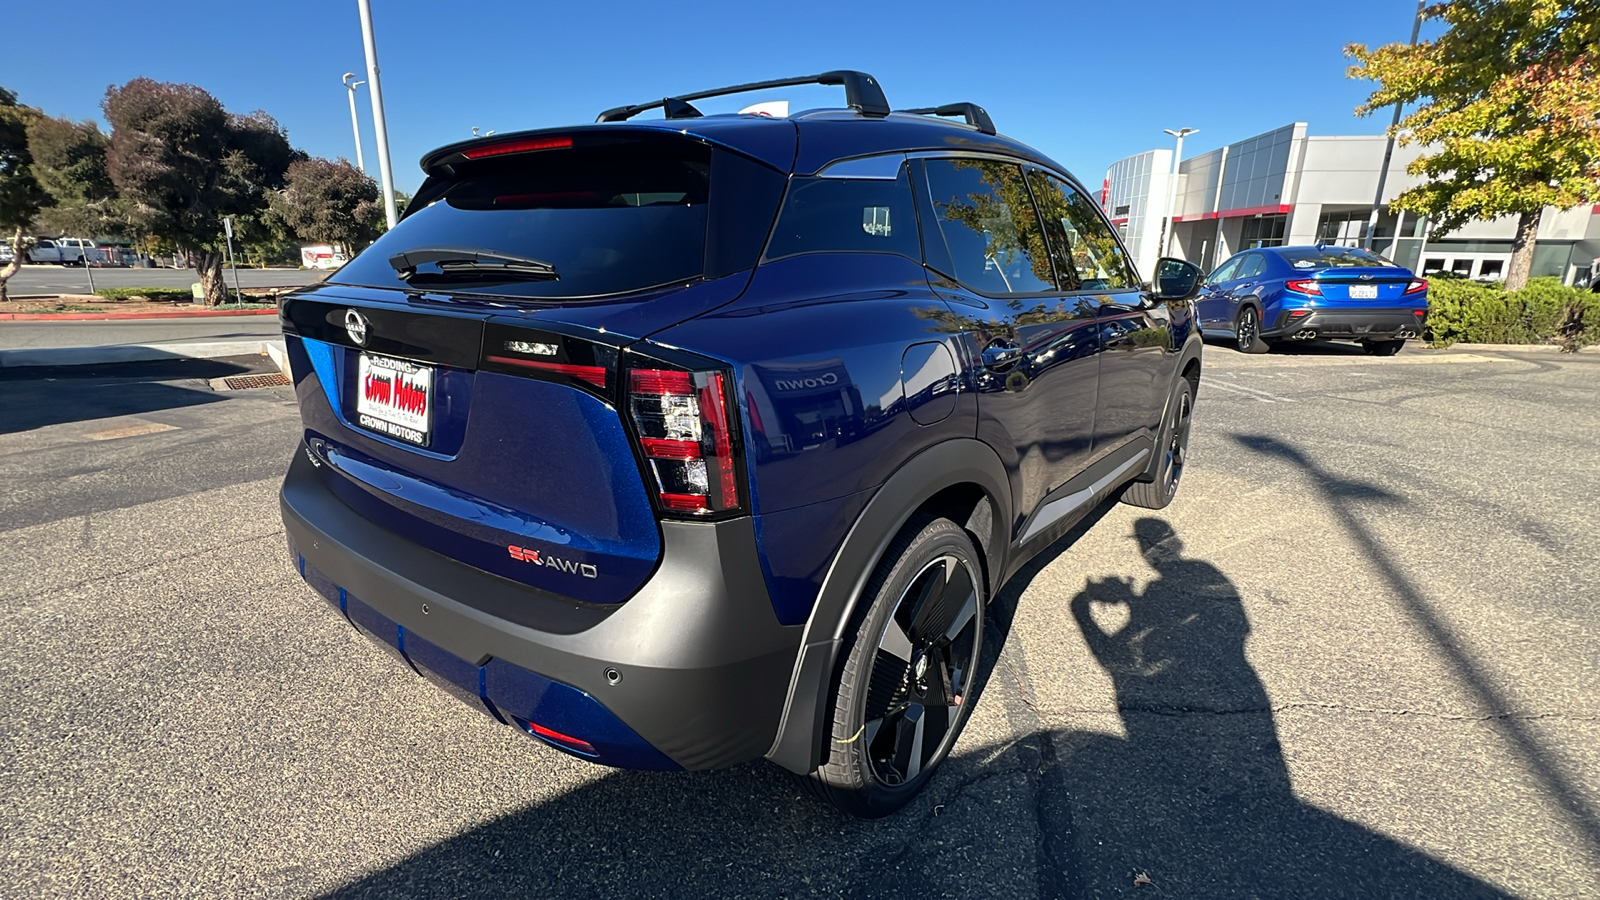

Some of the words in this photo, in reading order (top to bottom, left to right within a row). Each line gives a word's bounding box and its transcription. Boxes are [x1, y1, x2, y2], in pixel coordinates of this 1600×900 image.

[373, 356, 412, 373] REDDING
[365, 366, 391, 406] Crown
[393, 371, 427, 417] Motors
[360, 414, 388, 432] CROWN
[388, 422, 423, 443] MOTORS
[545, 556, 598, 578] AWD
